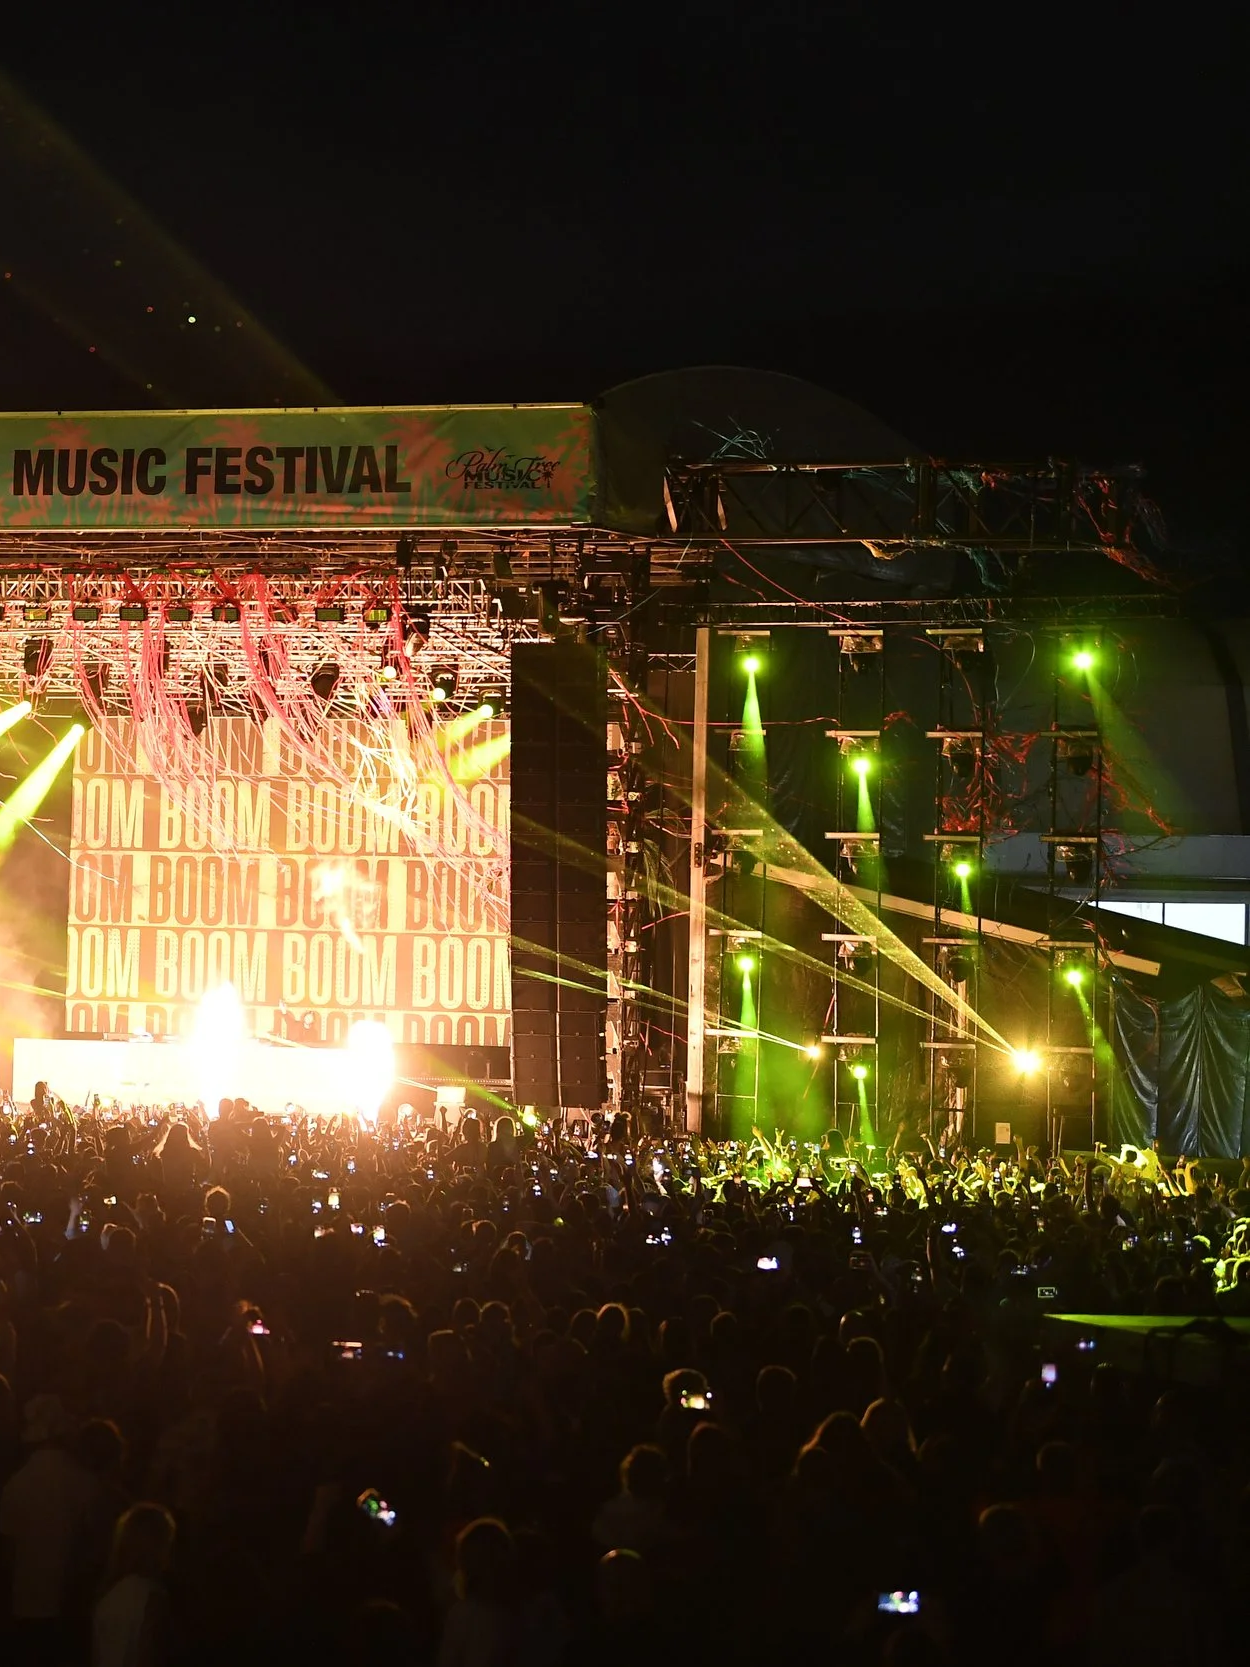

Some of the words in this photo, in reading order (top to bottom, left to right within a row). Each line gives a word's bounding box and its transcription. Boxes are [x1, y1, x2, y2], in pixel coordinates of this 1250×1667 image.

[13, 447, 166, 497] MUSIC
[185, 445, 411, 495] FESTIVAL
[464, 468, 541, 482] MUSIC
[464, 481, 541, 490] FESTIVAL
[158, 778, 271, 852] BOOM
[286, 780, 400, 856] BOOM
[149, 855, 261, 926] BOOM
[155, 929, 268, 1003] BOOM
[283, 932, 398, 1007] BOOM
